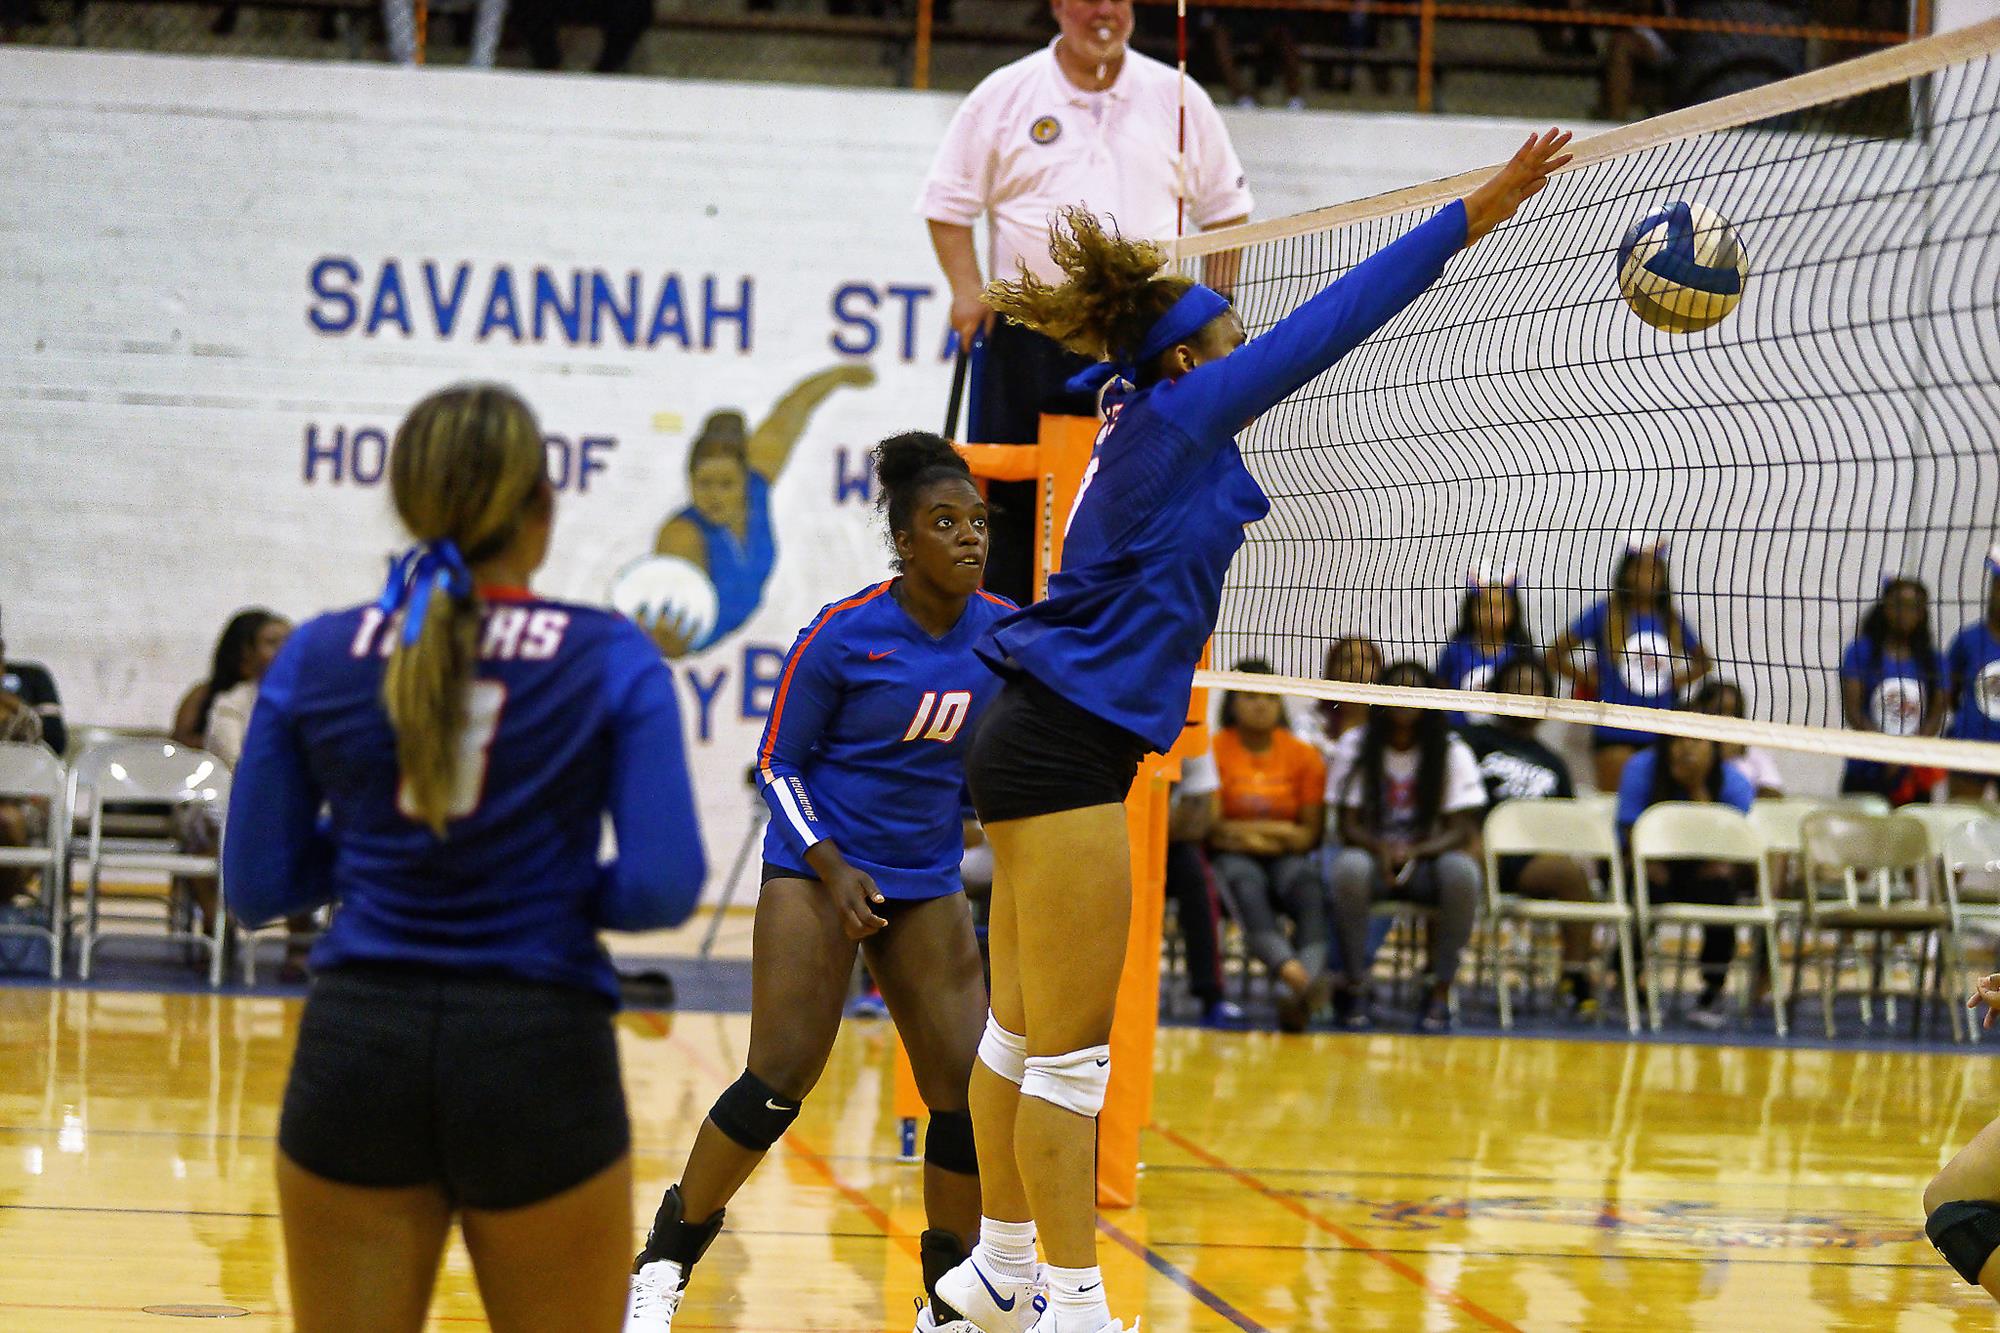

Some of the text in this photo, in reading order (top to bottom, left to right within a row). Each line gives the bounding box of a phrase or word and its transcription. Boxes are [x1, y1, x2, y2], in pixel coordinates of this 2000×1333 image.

[307, 256, 959, 360] SAVANNAH ST
[305, 423, 388, 484] HO
[903, 690, 972, 743] 10
